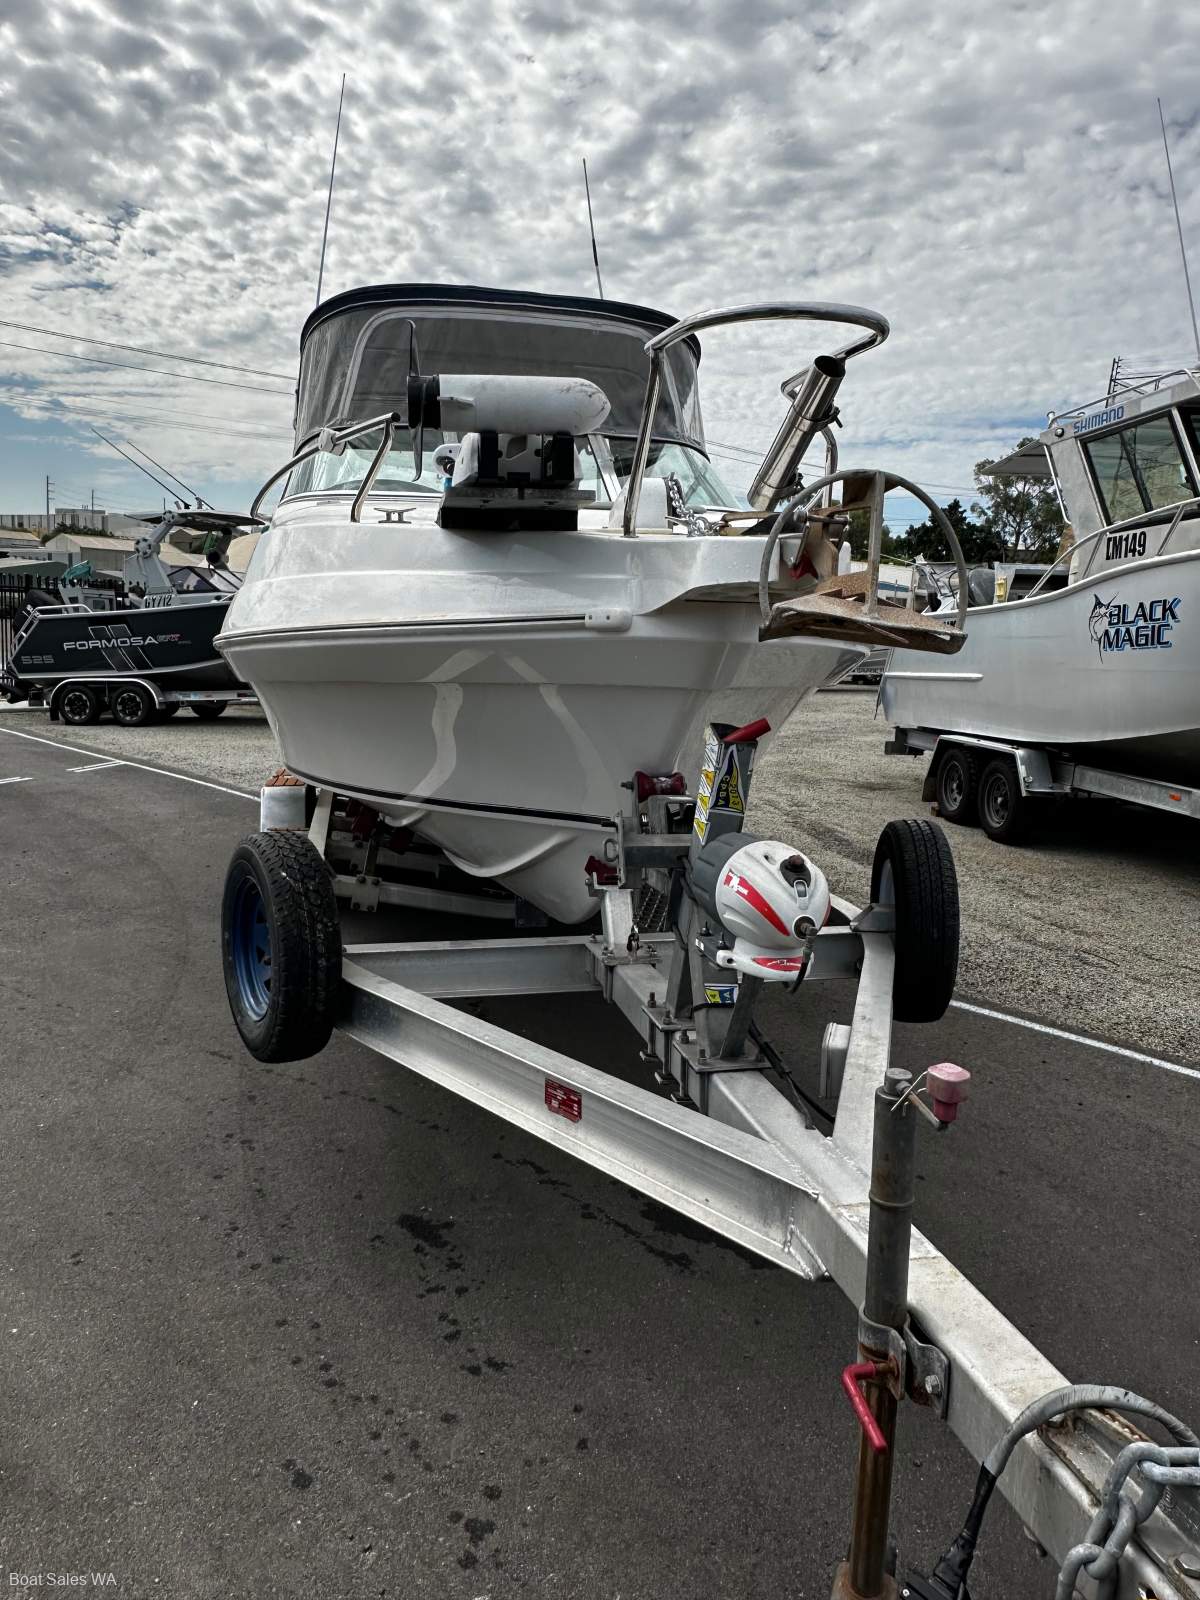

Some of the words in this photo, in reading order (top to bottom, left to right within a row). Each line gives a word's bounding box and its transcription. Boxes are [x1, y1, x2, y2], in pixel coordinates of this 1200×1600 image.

[1073, 405, 1125, 434] SHIMANO
[1108, 598, 1182, 627] BLACK
[63, 636, 158, 651] FORMOSA
[1103, 624, 1173, 652] MAGIC
